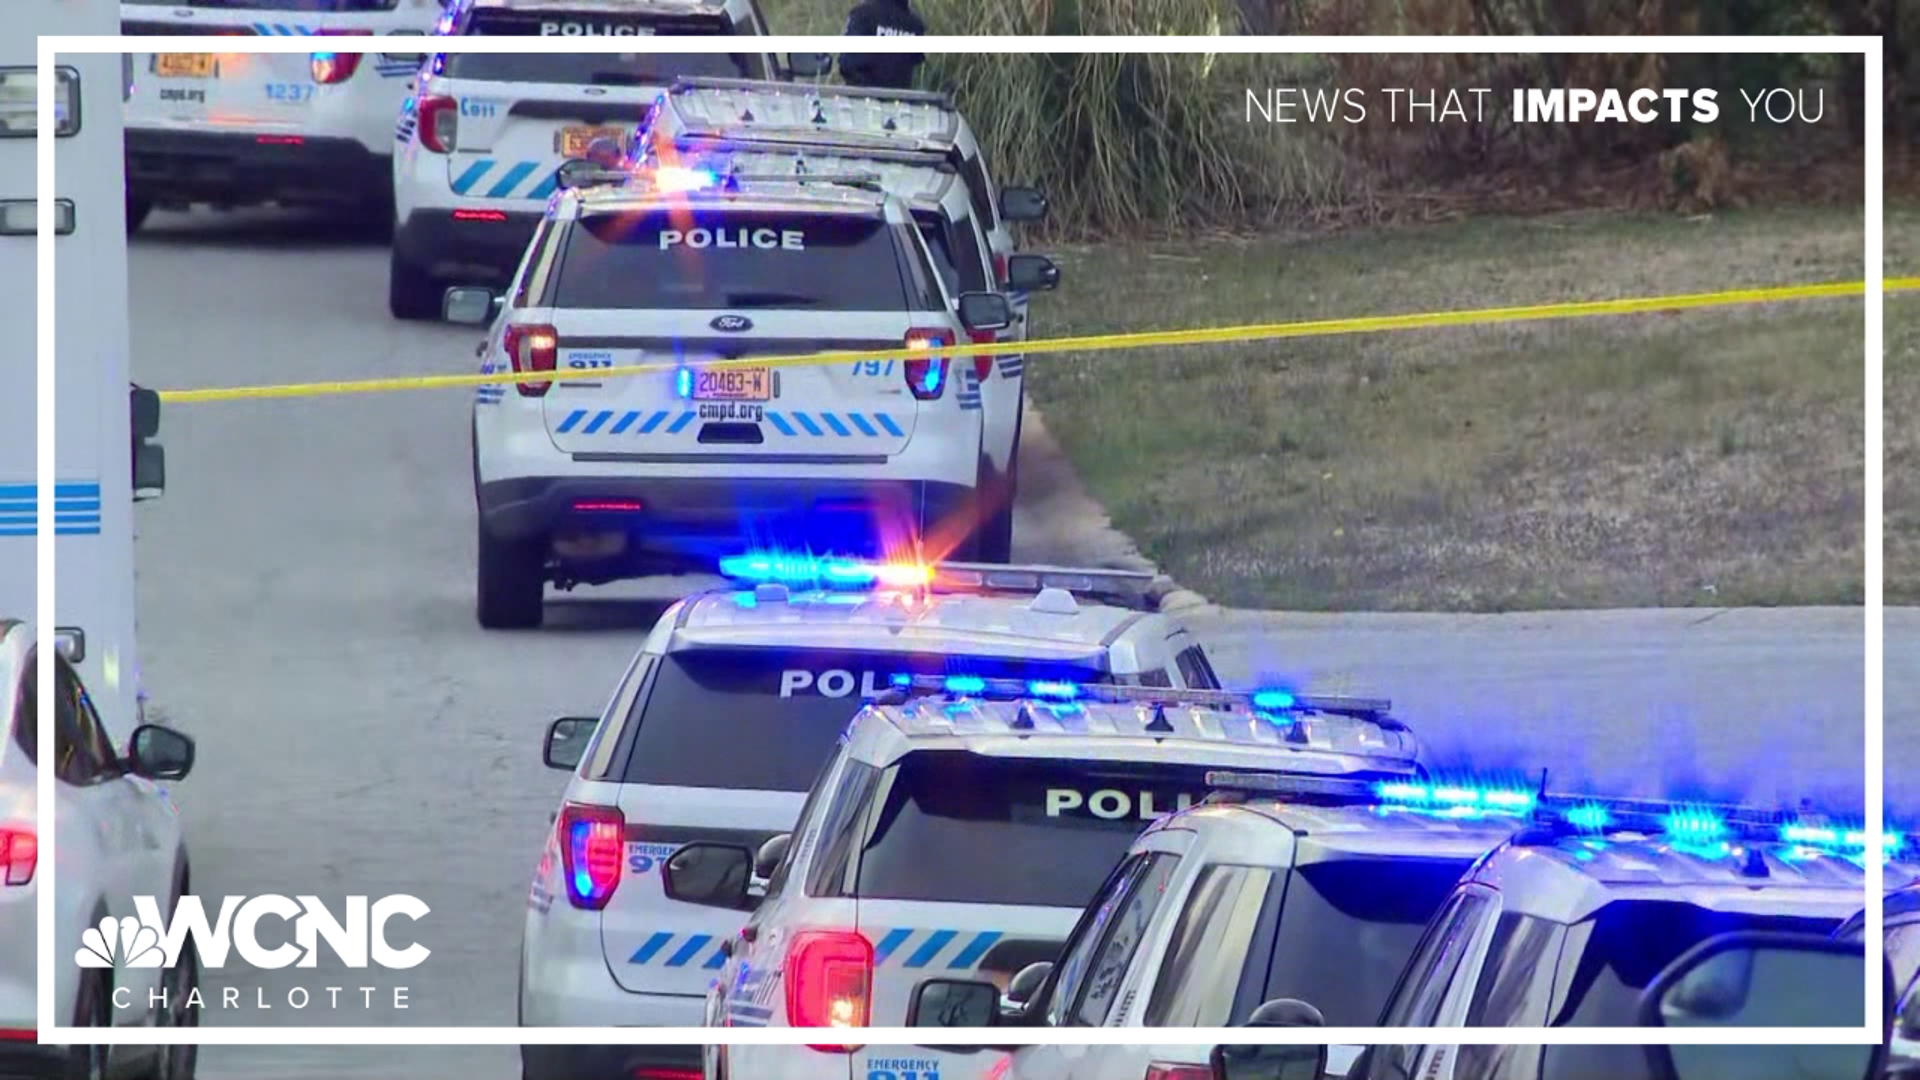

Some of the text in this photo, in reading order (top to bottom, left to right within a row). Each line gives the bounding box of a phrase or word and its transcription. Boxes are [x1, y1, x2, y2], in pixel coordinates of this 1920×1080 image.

[541, 22, 656, 36] POLICE
[265, 84, 314, 101] 1237
[659, 230, 804, 254] POLICE
[700, 401, 763, 422] cmpd.org
[868, 1058, 939, 1070] EMERGENCY
